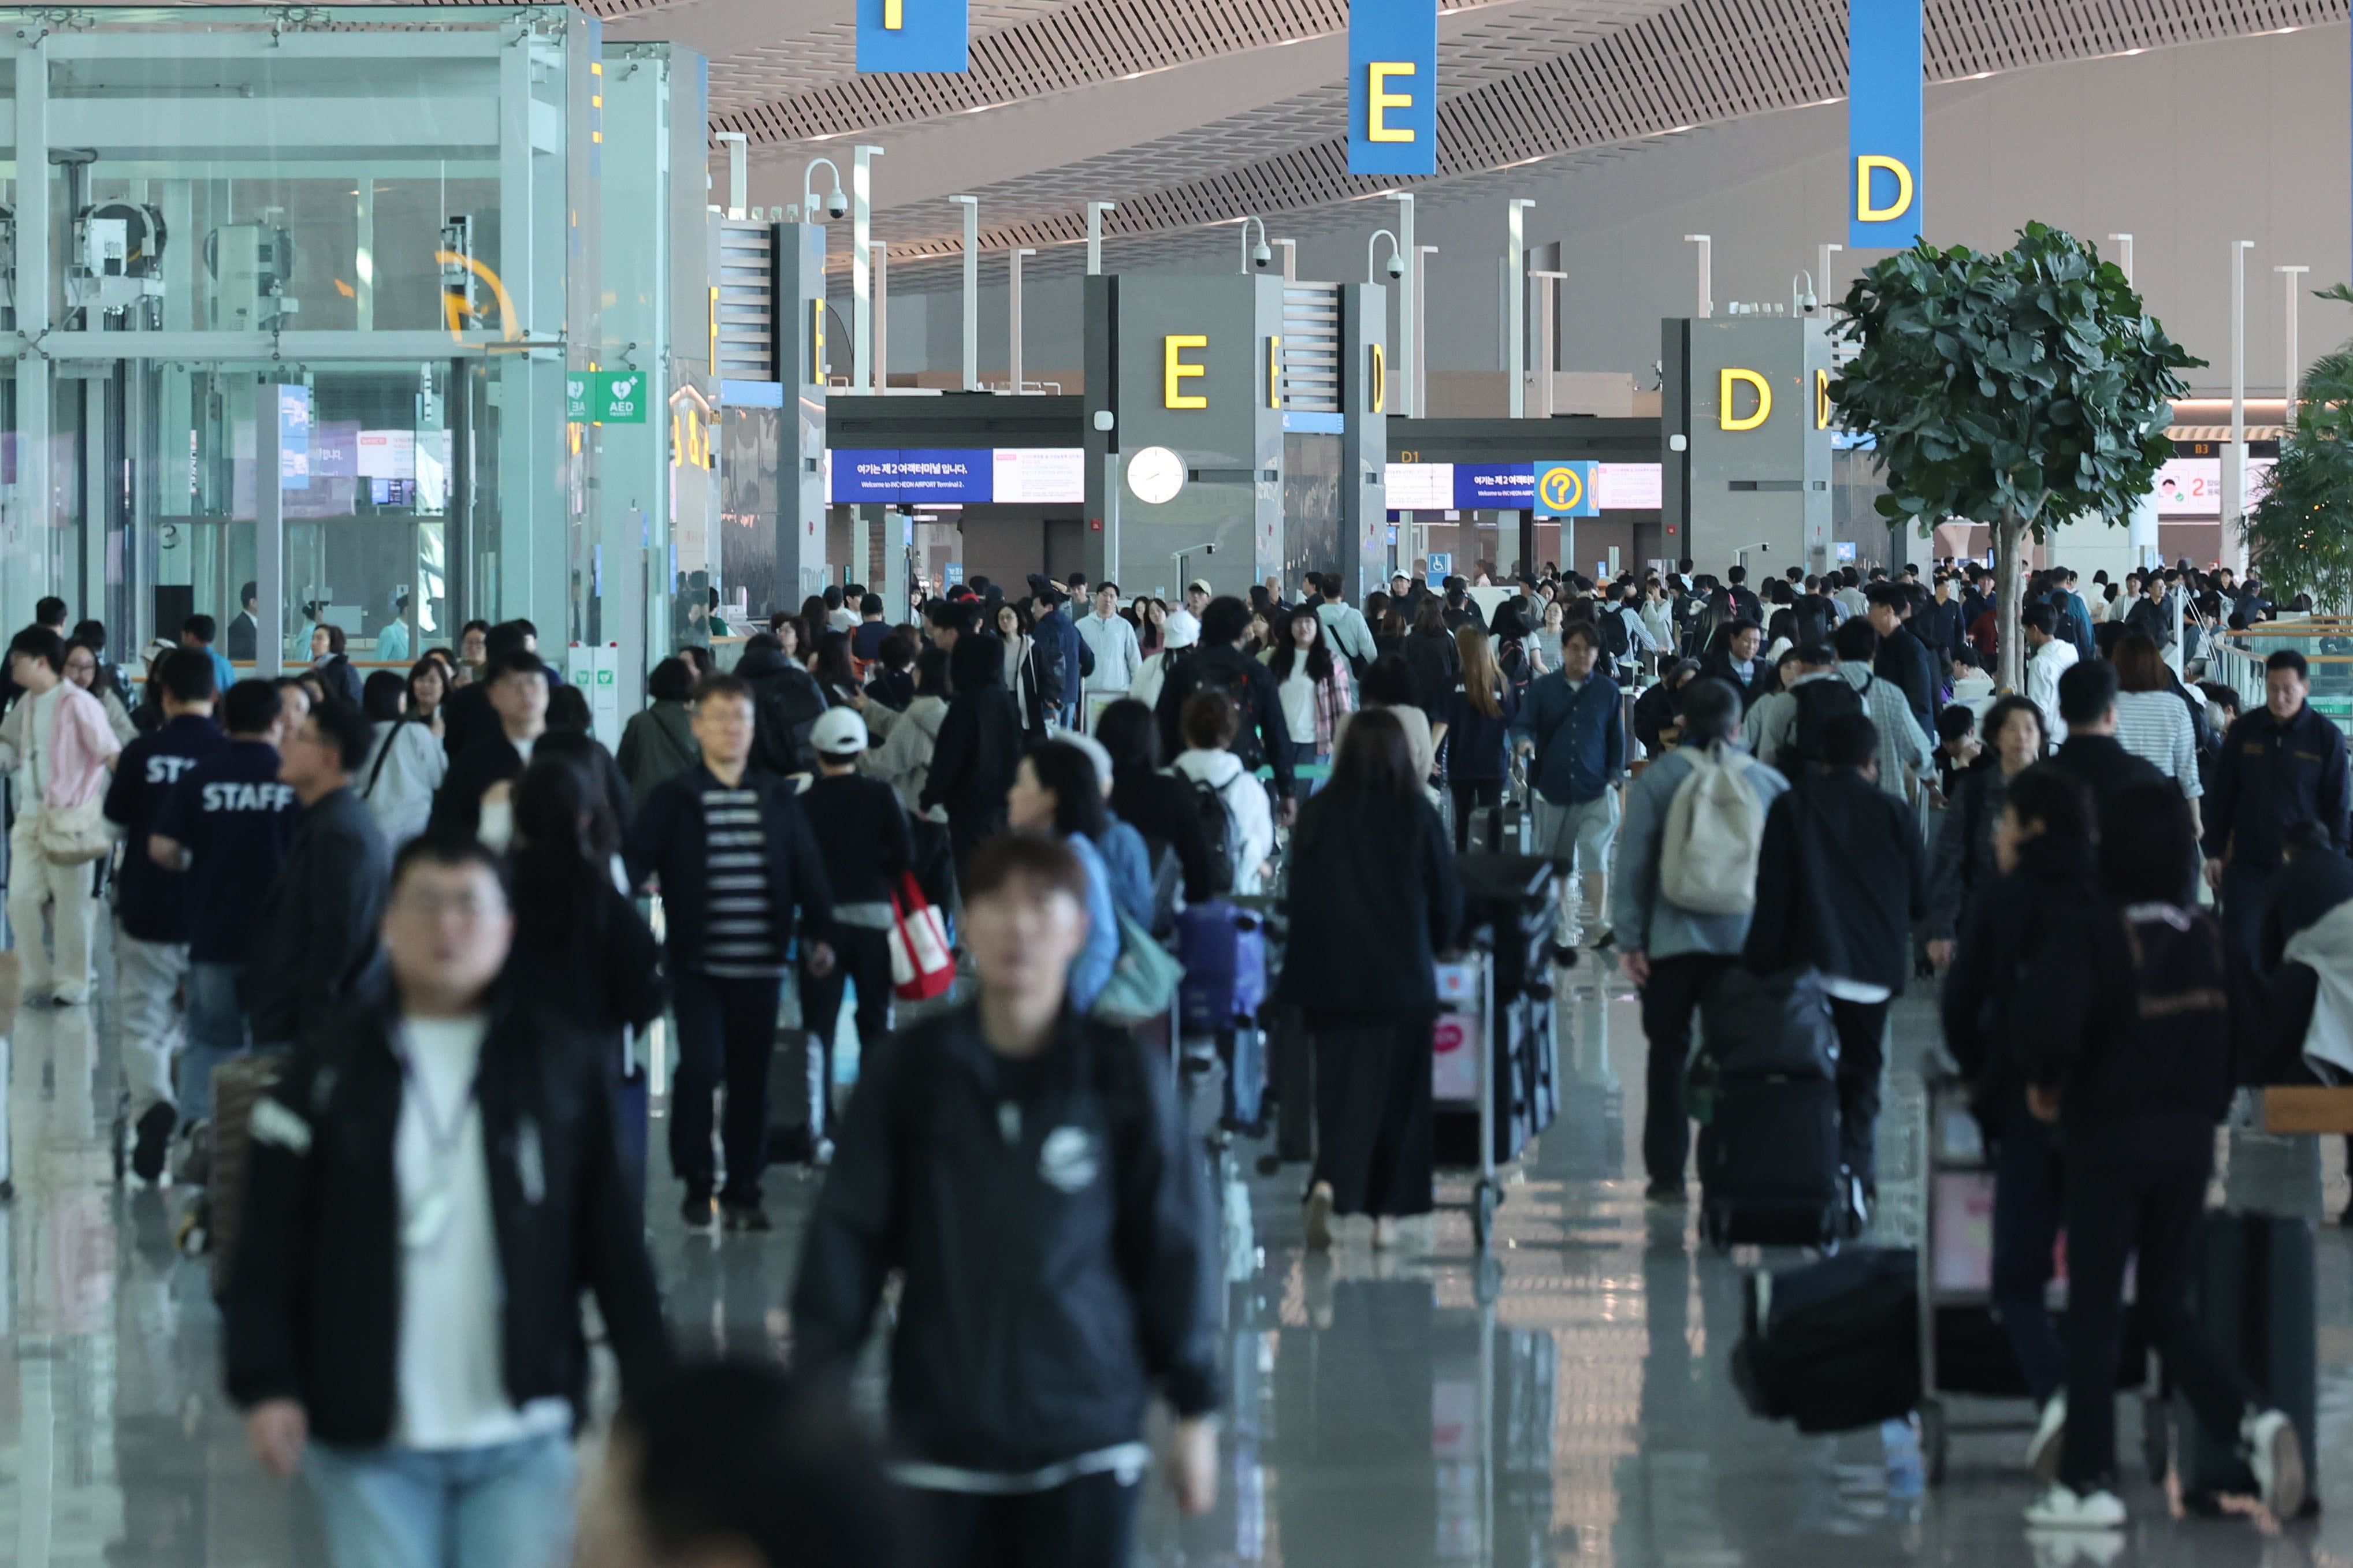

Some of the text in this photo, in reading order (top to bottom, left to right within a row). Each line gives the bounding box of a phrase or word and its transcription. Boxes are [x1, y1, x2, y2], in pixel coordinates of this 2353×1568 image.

[1368, 61, 1415, 142] E
[1856, 155, 1913, 222] D
[815, 298, 824, 385] E
[1165, 335, 1207, 409] E
[1271, 336, 1280, 409] E
[609, 401, 634, 412] AED
[1373, 343, 1384, 414] D
[1720, 368, 1772, 431] D
[1817, 368, 1830, 430] D
[857, 463, 968, 475] 여기는 제 2 여객터미널 입니다.
[1401, 450, 1419, 463] D1
[1474, 476, 1495, 486] 여기는
[1495, 475, 1503, 485] 제
[1503, 476, 1508, 485] 2
[2192, 478, 2204, 497] 2
[202, 781, 295, 813] STAFF
